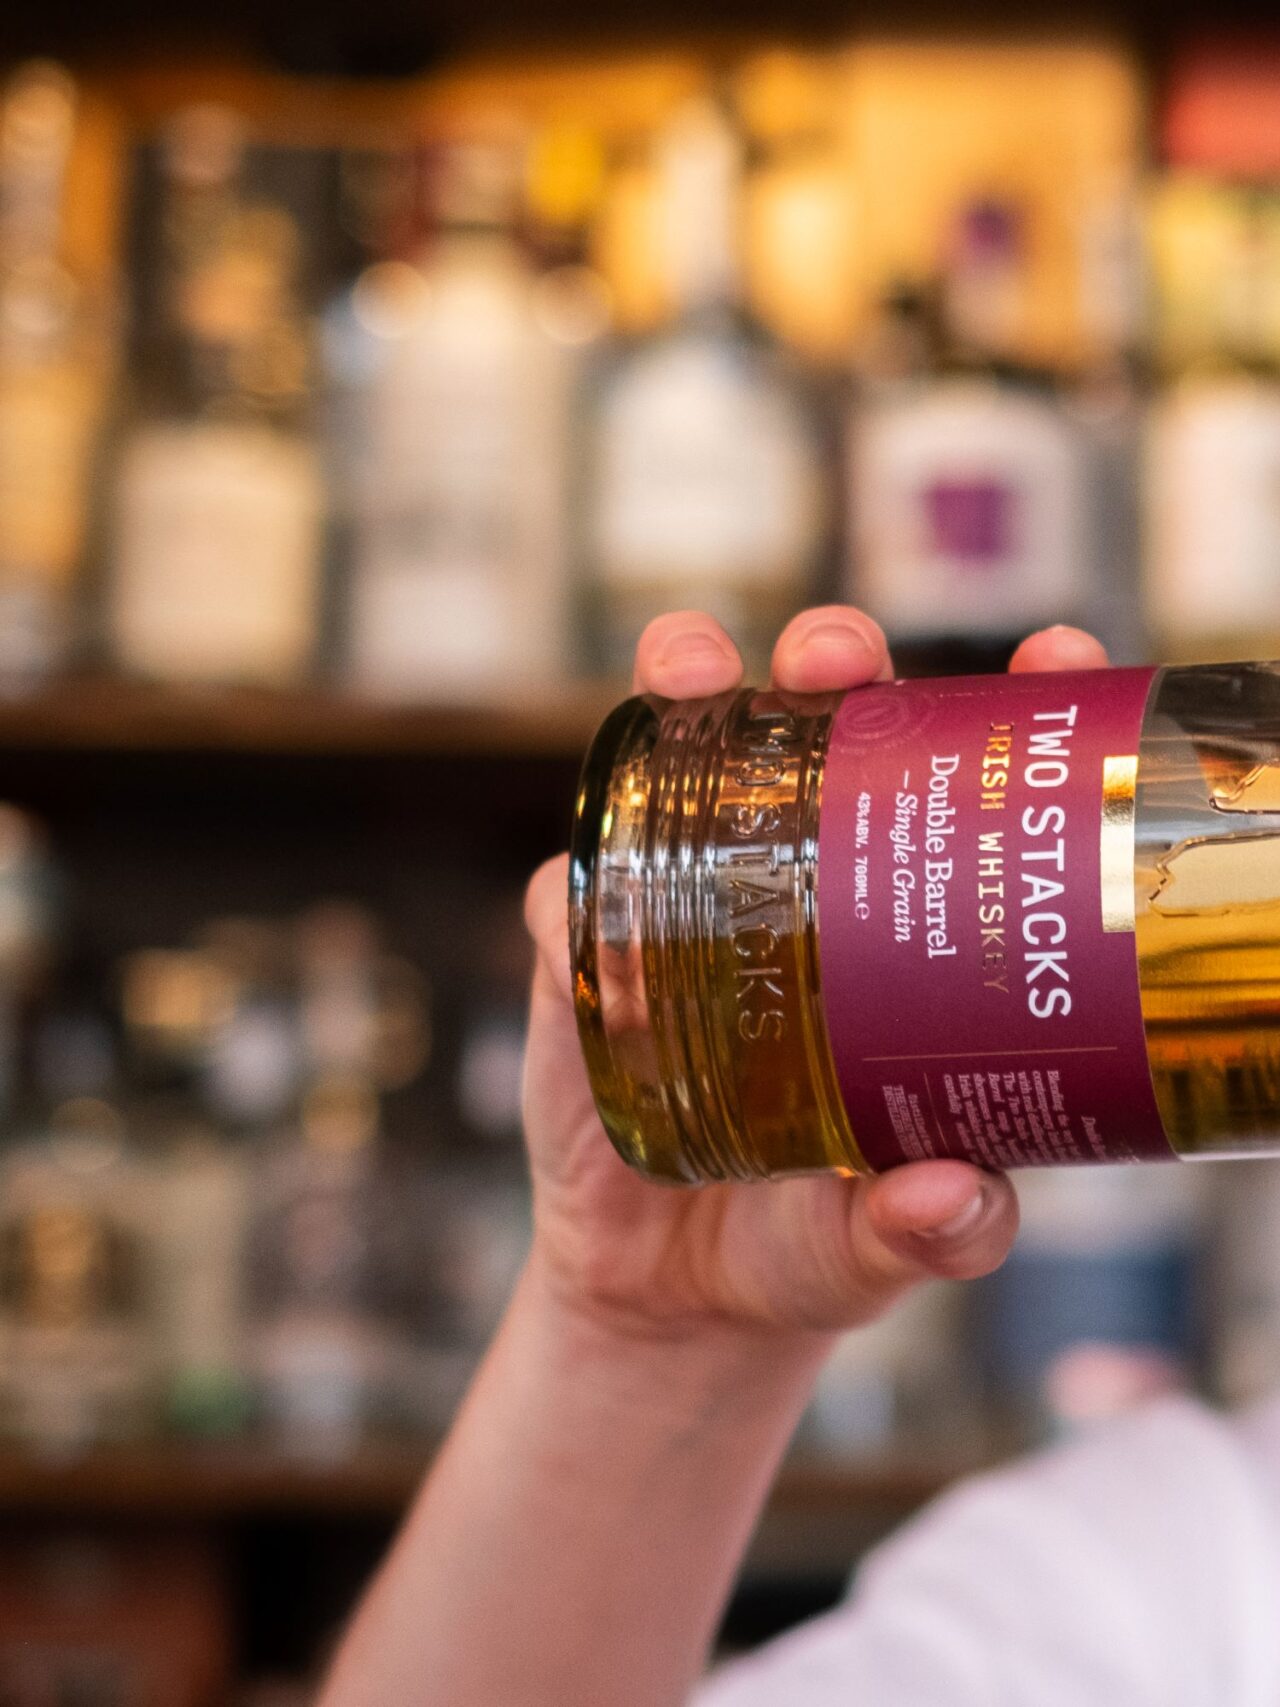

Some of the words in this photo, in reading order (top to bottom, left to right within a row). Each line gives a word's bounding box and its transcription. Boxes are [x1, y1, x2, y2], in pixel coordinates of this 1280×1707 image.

[979, 721, 1016, 811] IRISH
[1023, 704, 1079, 788] TWO
[924, 753, 960, 855] Double
[728, 802, 790, 1044] STACKS
[891, 868, 917, 943] Grain
[924, 857, 958, 960] Barrel
[978, 830, 1010, 995] WHISKEY
[1020, 804, 1073, 1019] STACKS
[957, 1074, 974, 1098] Irish
[1002, 1072, 1016, 1093] The
